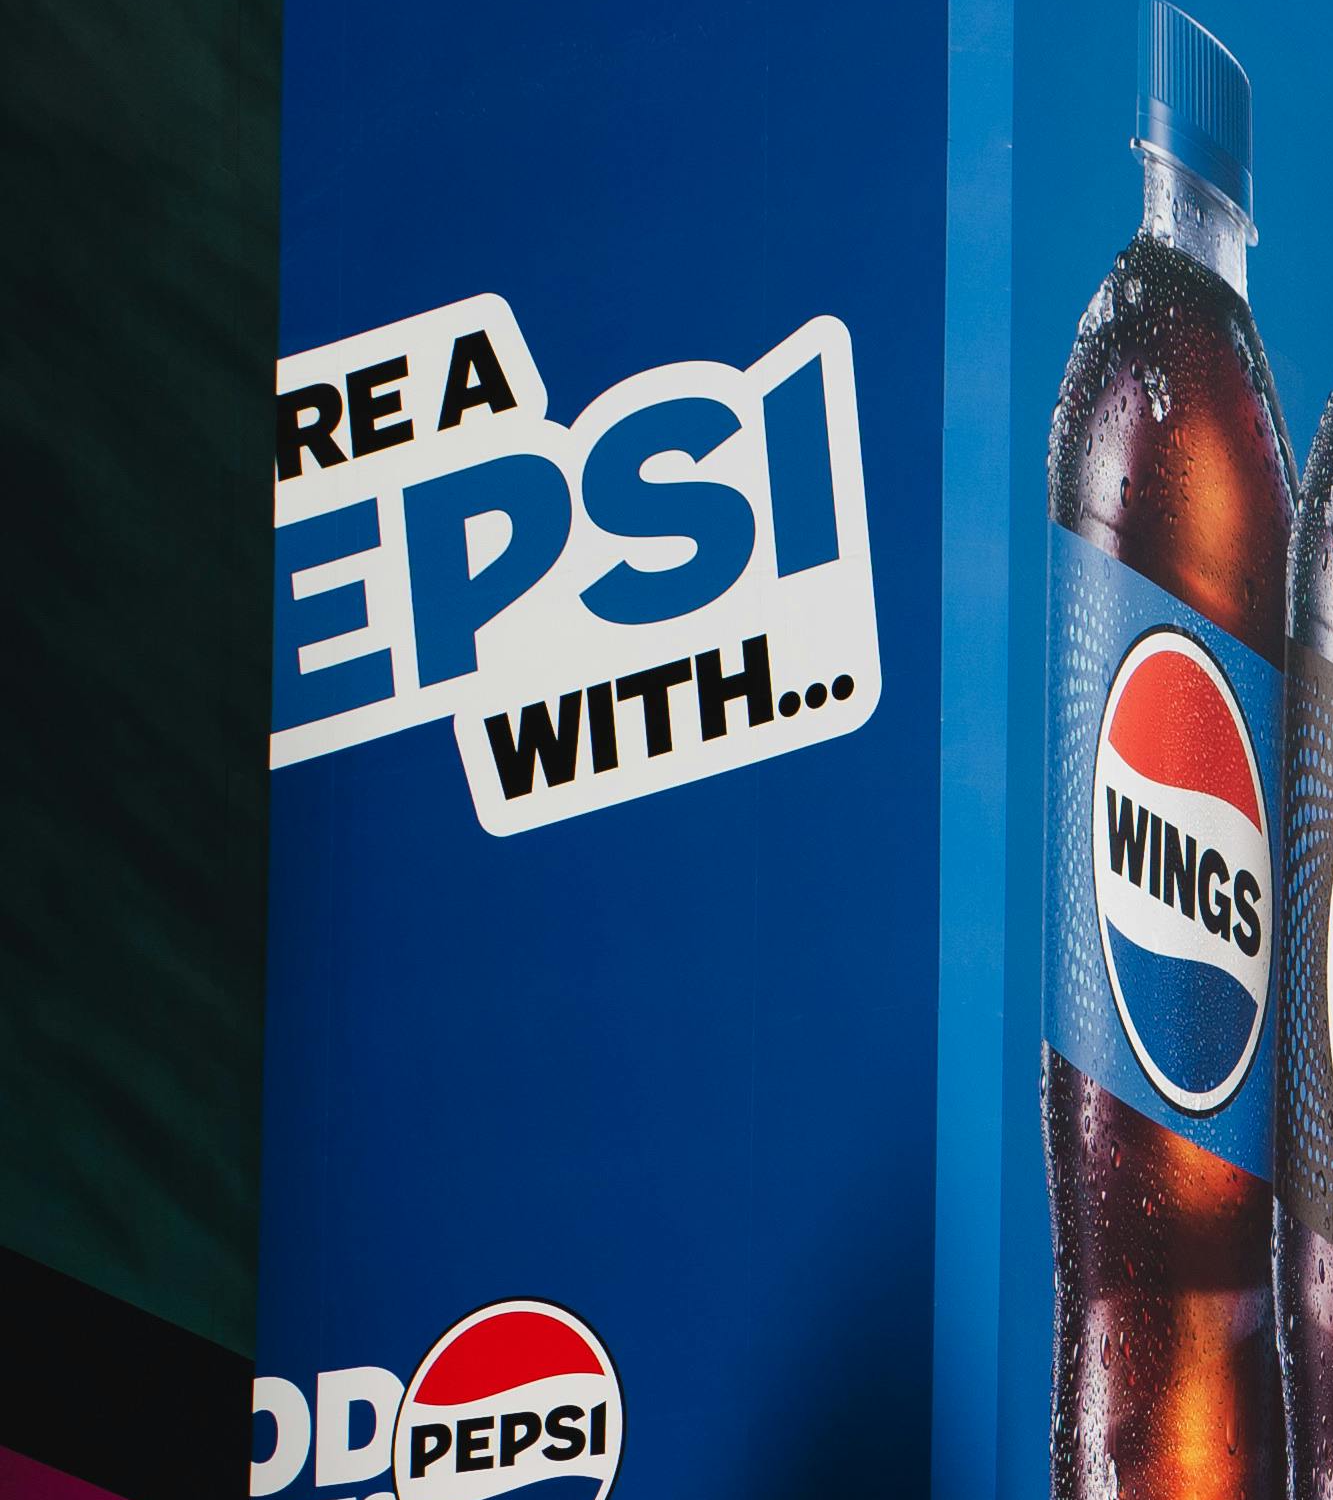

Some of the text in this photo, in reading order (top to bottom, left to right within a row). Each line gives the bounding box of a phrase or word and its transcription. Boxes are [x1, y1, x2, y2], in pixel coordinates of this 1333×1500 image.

[438, 329, 518, 432] A
[270, 352, 840, 735] EPSI
[483, 633, 855, 801] WITH...
[1106, 786, 1262, 958] WINGS
[410, 1400, 607, 1480] PEPSI
